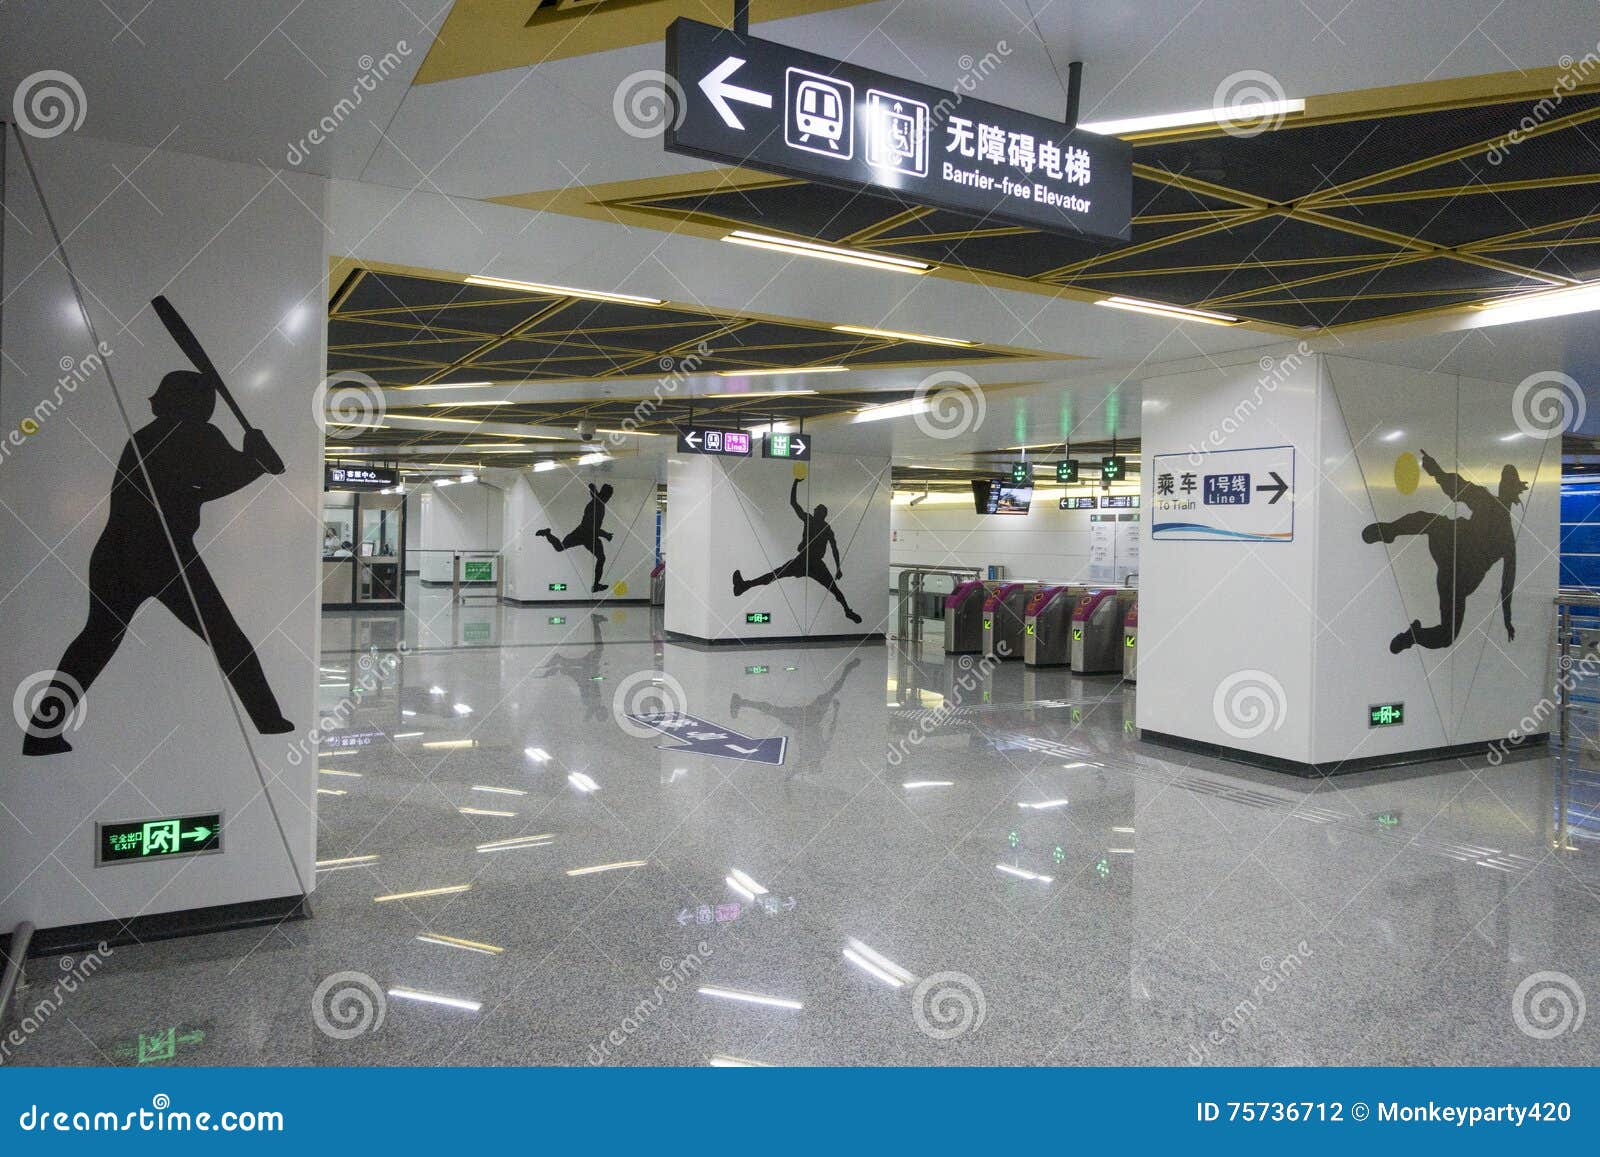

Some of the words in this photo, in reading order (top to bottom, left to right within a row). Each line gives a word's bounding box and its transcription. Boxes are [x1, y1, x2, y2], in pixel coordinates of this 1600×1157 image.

[945, 116, 1091, 186] 无障碍电梯
[943, 162, 1031, 199] Barrier-free
[1034, 184, 1091, 213] Elevator
[1208, 474, 1247, 493] 1号线
[1158, 499, 1170, 510] To
[1173, 499, 1196, 511] Train
[1208, 494, 1236, 504] Line
[1239, 493, 1246, 504] 1
[109, 831, 143, 845] 安全出口
[114, 842, 137, 851] EXIT
